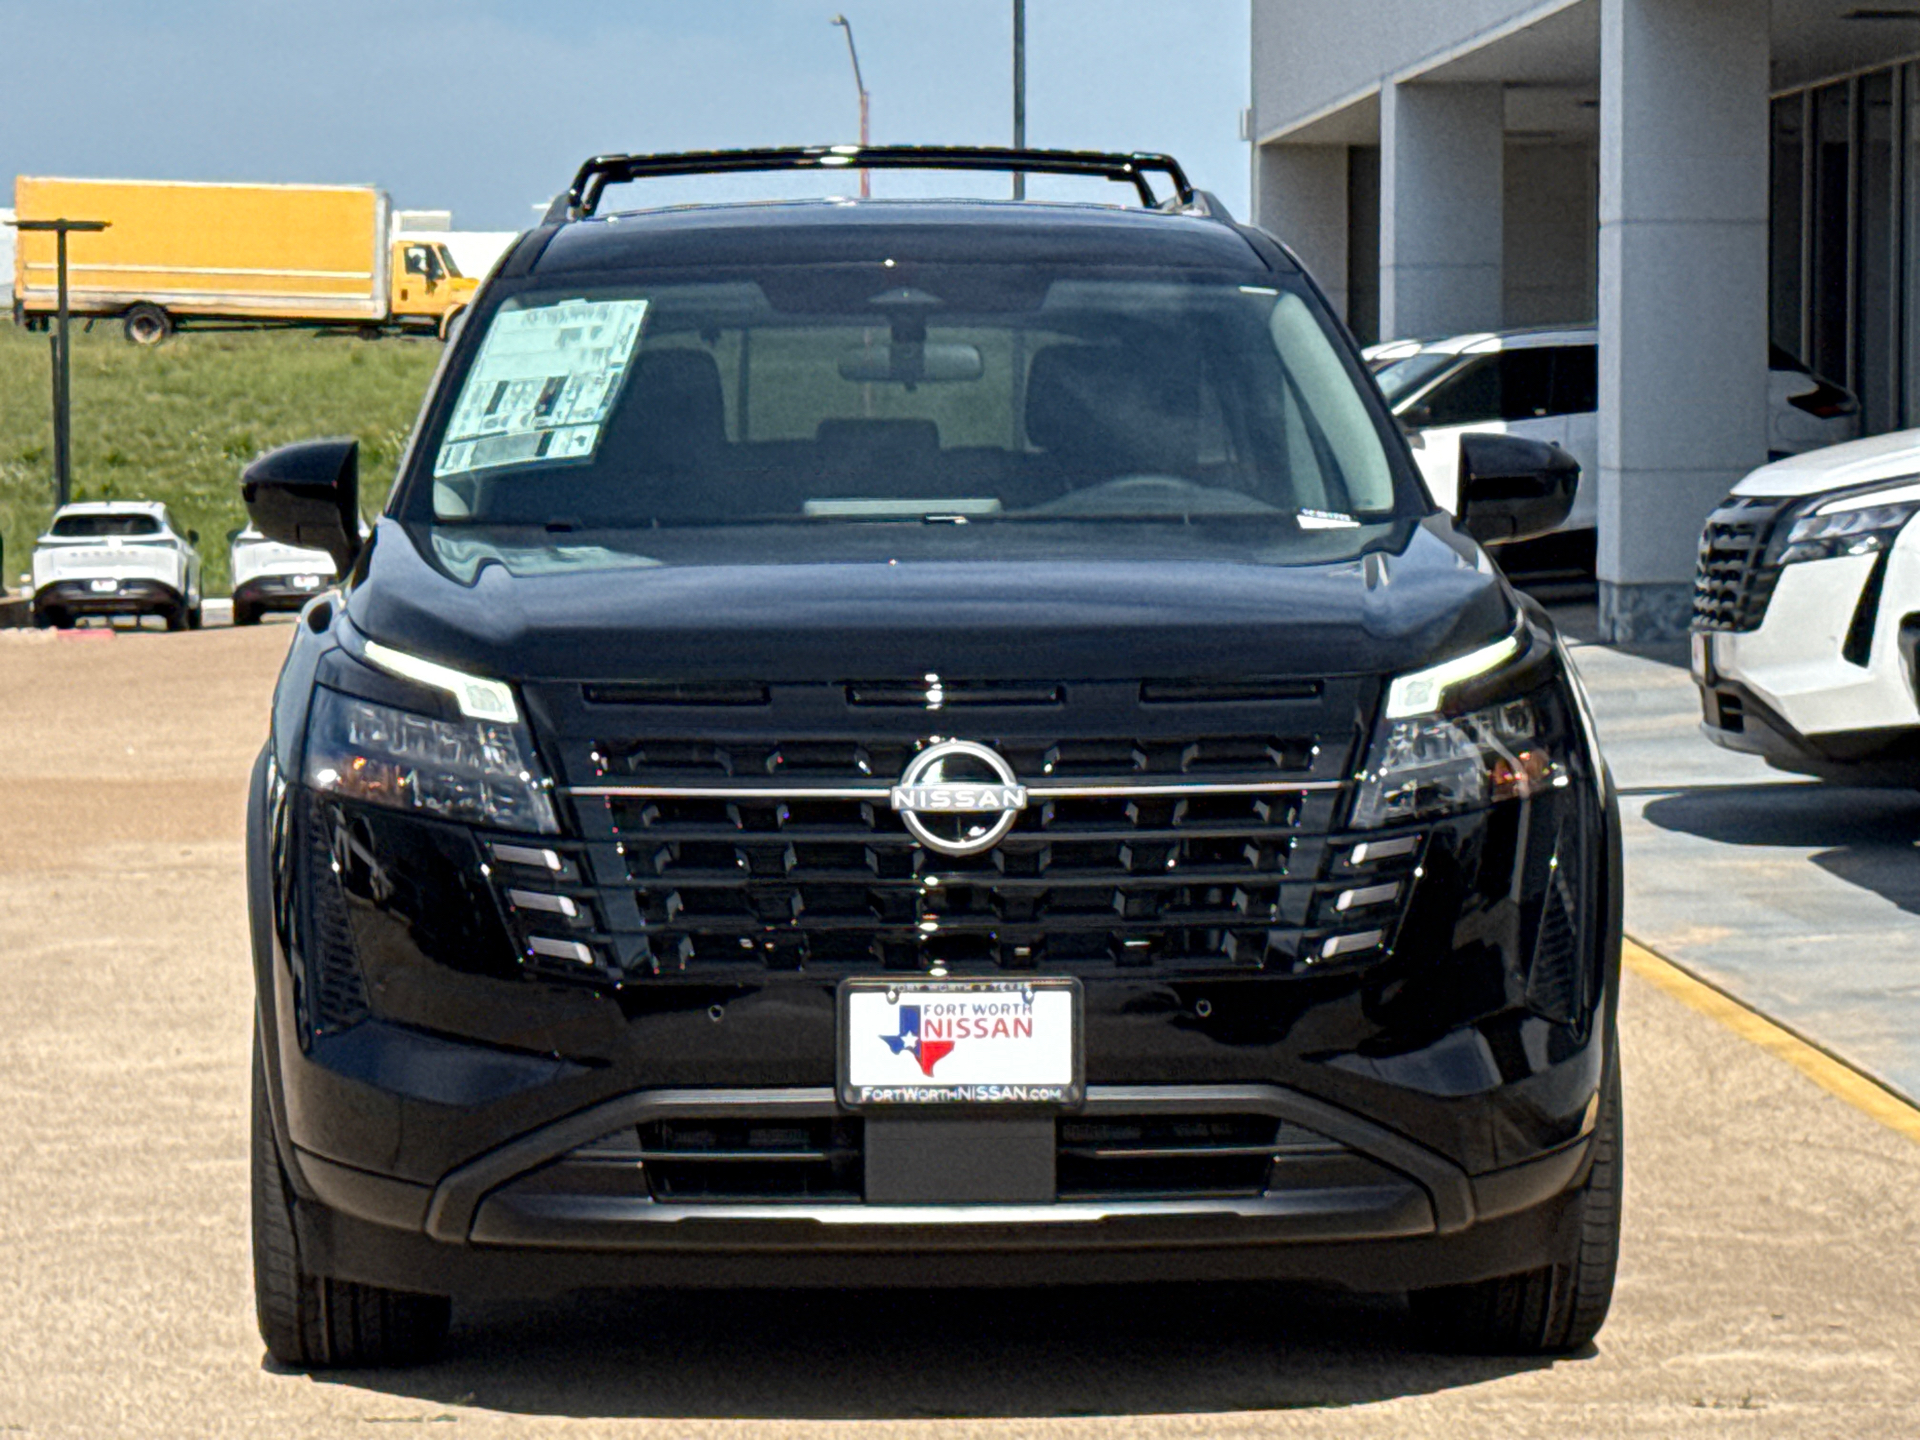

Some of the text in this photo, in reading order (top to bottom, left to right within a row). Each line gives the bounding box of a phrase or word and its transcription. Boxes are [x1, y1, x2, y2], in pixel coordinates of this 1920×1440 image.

[894, 790, 1024, 808] NISSAN
[924, 1003, 1033, 1015] FORT WORTH
[925, 1018, 1033, 1039] NISSAN
